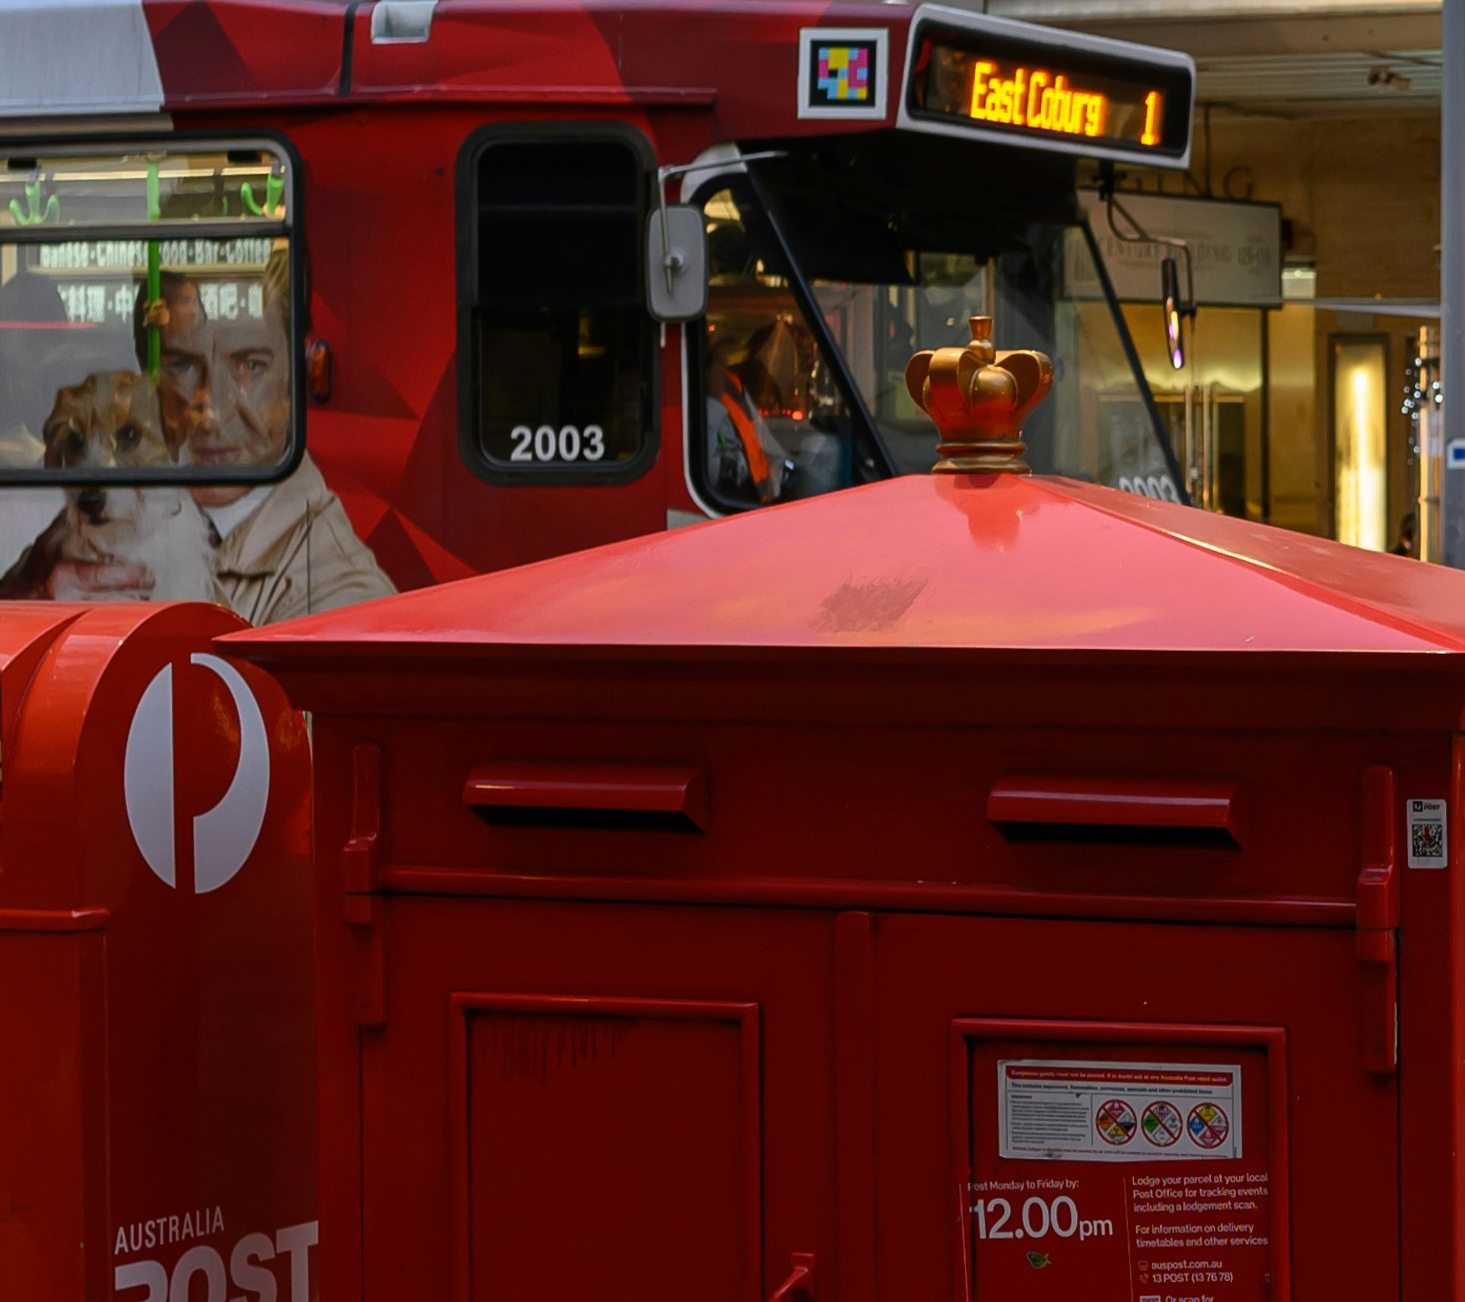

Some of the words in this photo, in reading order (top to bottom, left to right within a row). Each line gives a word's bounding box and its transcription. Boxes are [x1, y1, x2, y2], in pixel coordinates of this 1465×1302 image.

[971, 61, 1026, 126] East
[1027, 70, 1105, 138] Coburg
[1141, 91, 1161, 146] 1
[510, 423, 606, 462] 2003
[989, 1180, 1025, 1193] Monday
[1026, 1180, 1035, 1190] to
[1036, 1179, 1064, 1192] Friday
[1065, 1179, 1079, 1191] by:
[1131, 1176, 1161, 1188] Lodge
[1161, 1176, 1181, 1186] your
[1183, 1174, 1213, 1186] parcel
[1213, 1174, 1223, 1184] at
[1223, 1174, 1245, 1186] your
[1245, 1172, 1269, 1184] local
[1133, 1188, 1155, 1200] Post
[1155, 1188, 1183, 1198] Office
[1185, 1188, 1197, 1198] for
[1199, 1186, 1237, 1198] tracking
[1237, 1186, 1269, 1196] events
[1133, 1202, 1175, 1214] including
[1183, 1200, 1233, 1212] lodgement
[1233, 1200, 1259, 1210] scan.
[114, 1205, 225, 1256] AUSTRALIA
[1135, 1224, 1151, 1234] For
[1151, 1224, 1203, 1234] information
[1203, 1224, 1215, 1234] on
[1217, 1222, 1255, 1234] delivery
[1135, 1238, 1185, 1248] timetables
[1185, 1236, 1203, 1246] and
[1203, 1236, 1229, 1246] other
[1229, 1236, 1269, 1246] services
[1151, 1260, 1223, 1272] auspost.com.au
[1151, 1272, 1163, 1284] 13
[1163, 1272, 1189, 1282] POST
[1191, 1272, 1205, 1284] (13
[1205, 1272, 1217, 1282] 76
[1217, 1272, 1233, 1282] 78)
